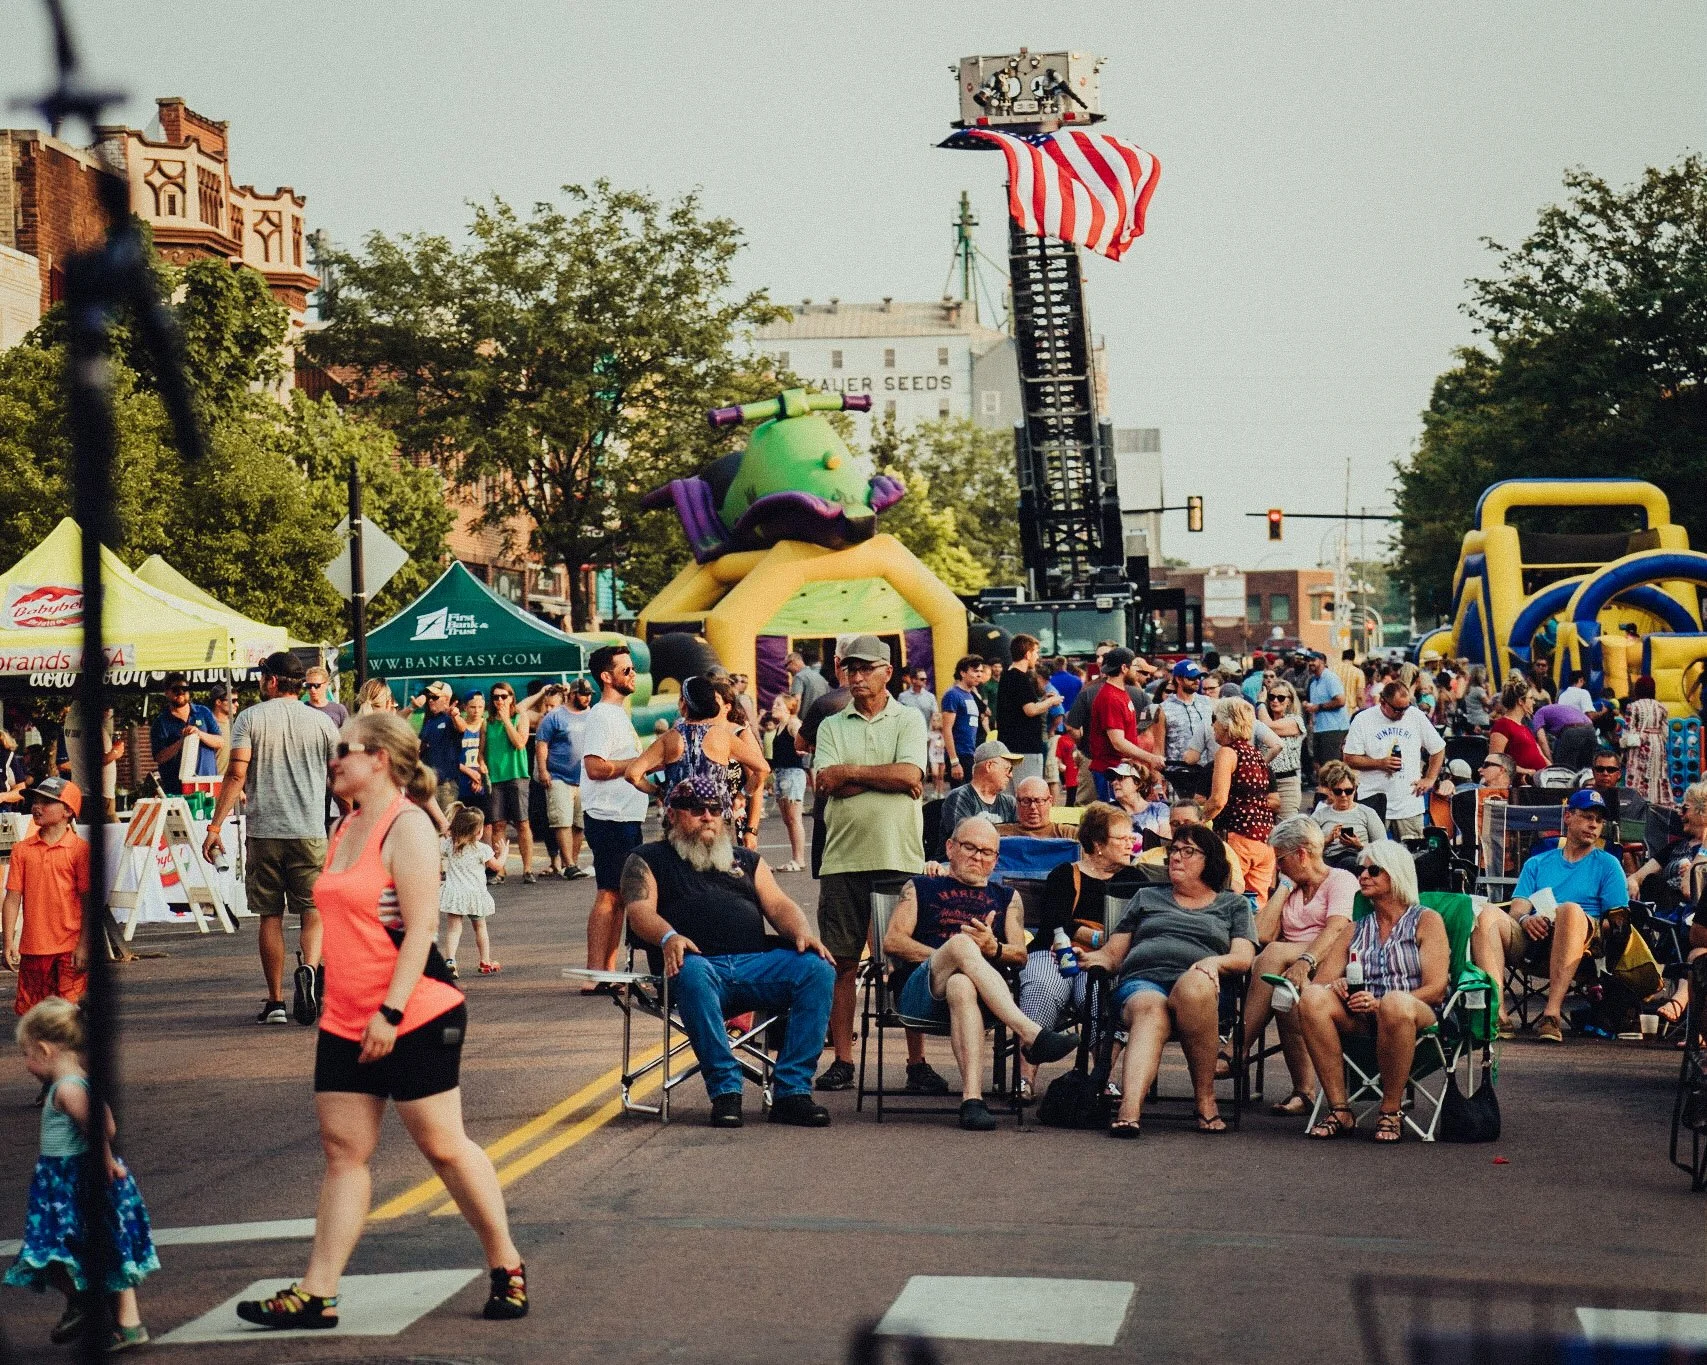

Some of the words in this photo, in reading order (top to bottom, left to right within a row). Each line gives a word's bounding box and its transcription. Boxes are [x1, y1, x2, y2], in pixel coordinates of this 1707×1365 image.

[797, 377, 872, 391] XAUER
[884, 375, 952, 391] SEEDS
[448, 613, 475, 622] First
[447, 621, 478, 629] Bank
[446, 628, 476, 636] Trust
[369, 653, 542, 671] WW.BANKEASY.COM
